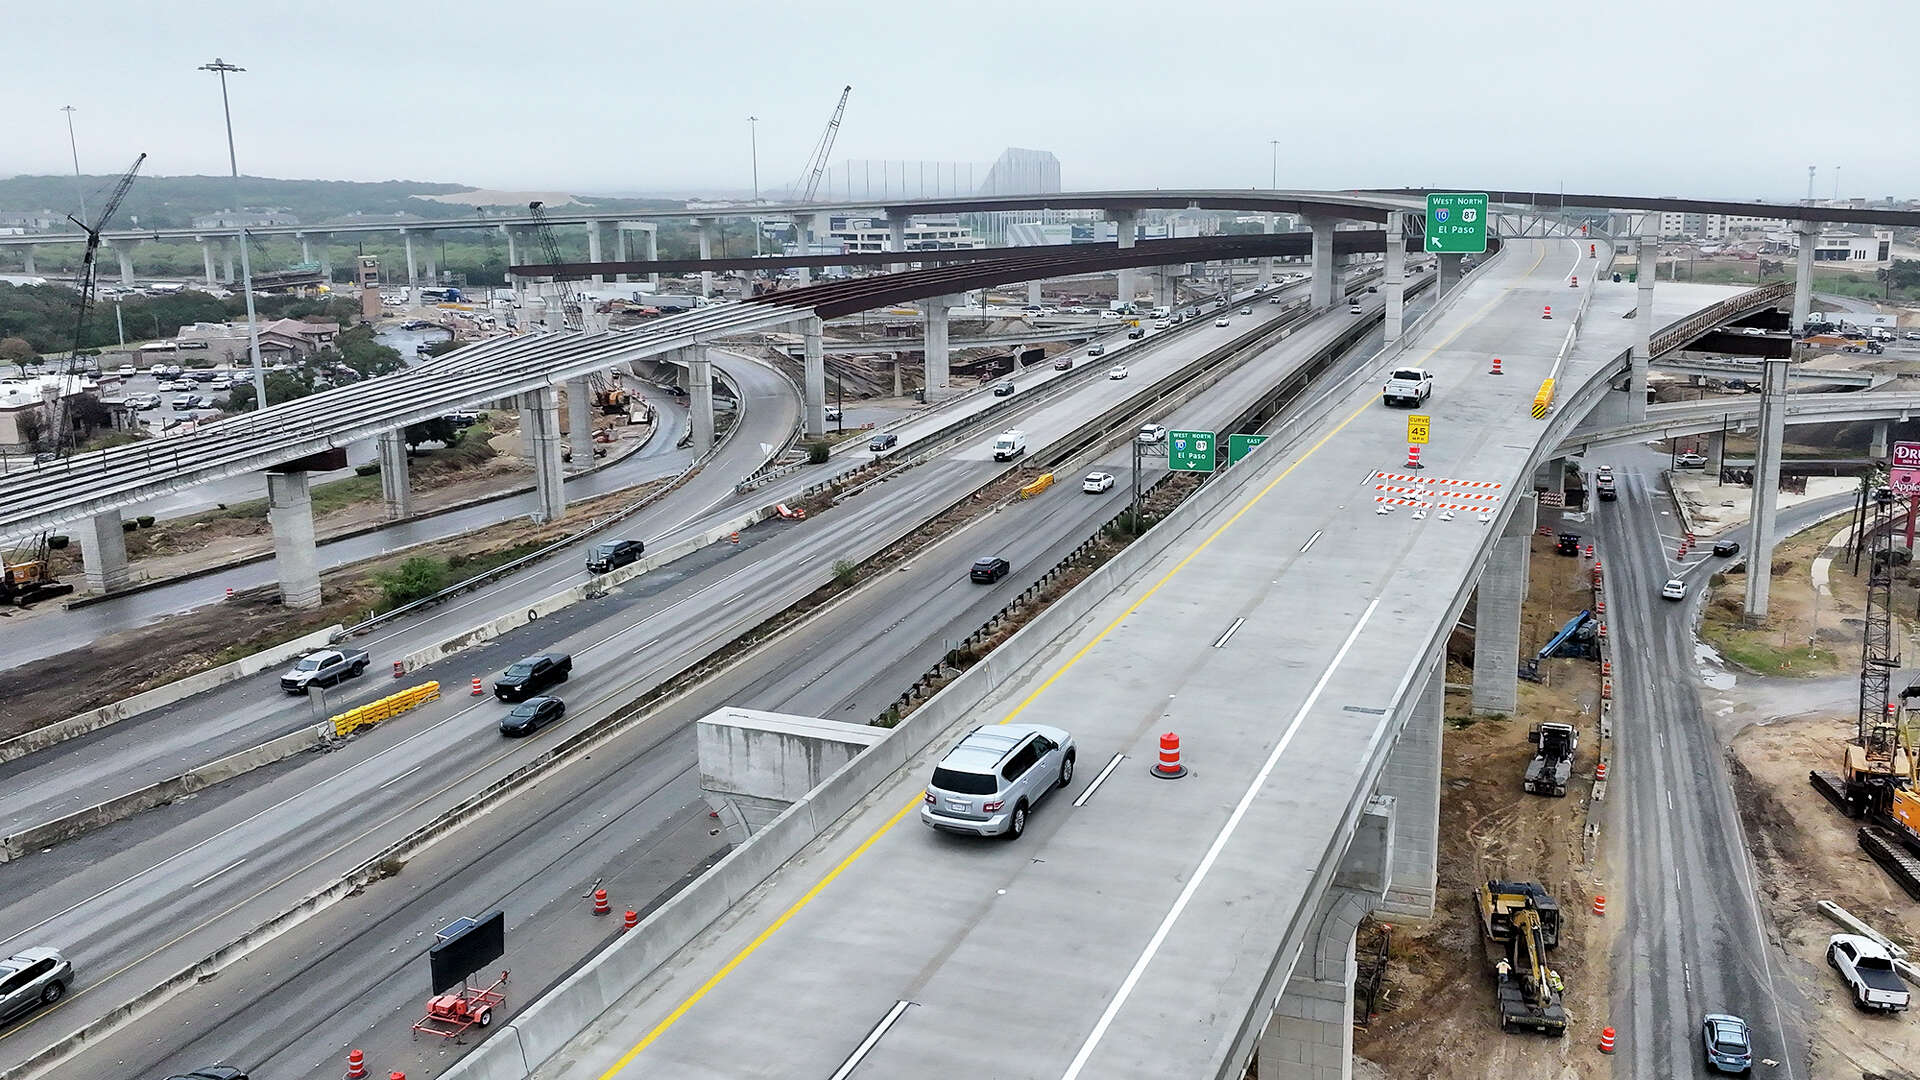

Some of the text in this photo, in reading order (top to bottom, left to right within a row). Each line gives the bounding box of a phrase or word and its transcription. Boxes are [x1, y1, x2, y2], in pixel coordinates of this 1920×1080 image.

[1432, 197, 1483, 205] WEST NORTH
[1438, 211, 1447, 220] 10
[1463, 211, 1475, 220] 87
[1438, 225, 1475, 234] El Paso
[1411, 427, 1426, 436] 45
[1188, 452, 1206, 460] Paso
[1895, 446, 1920, 459] DR
